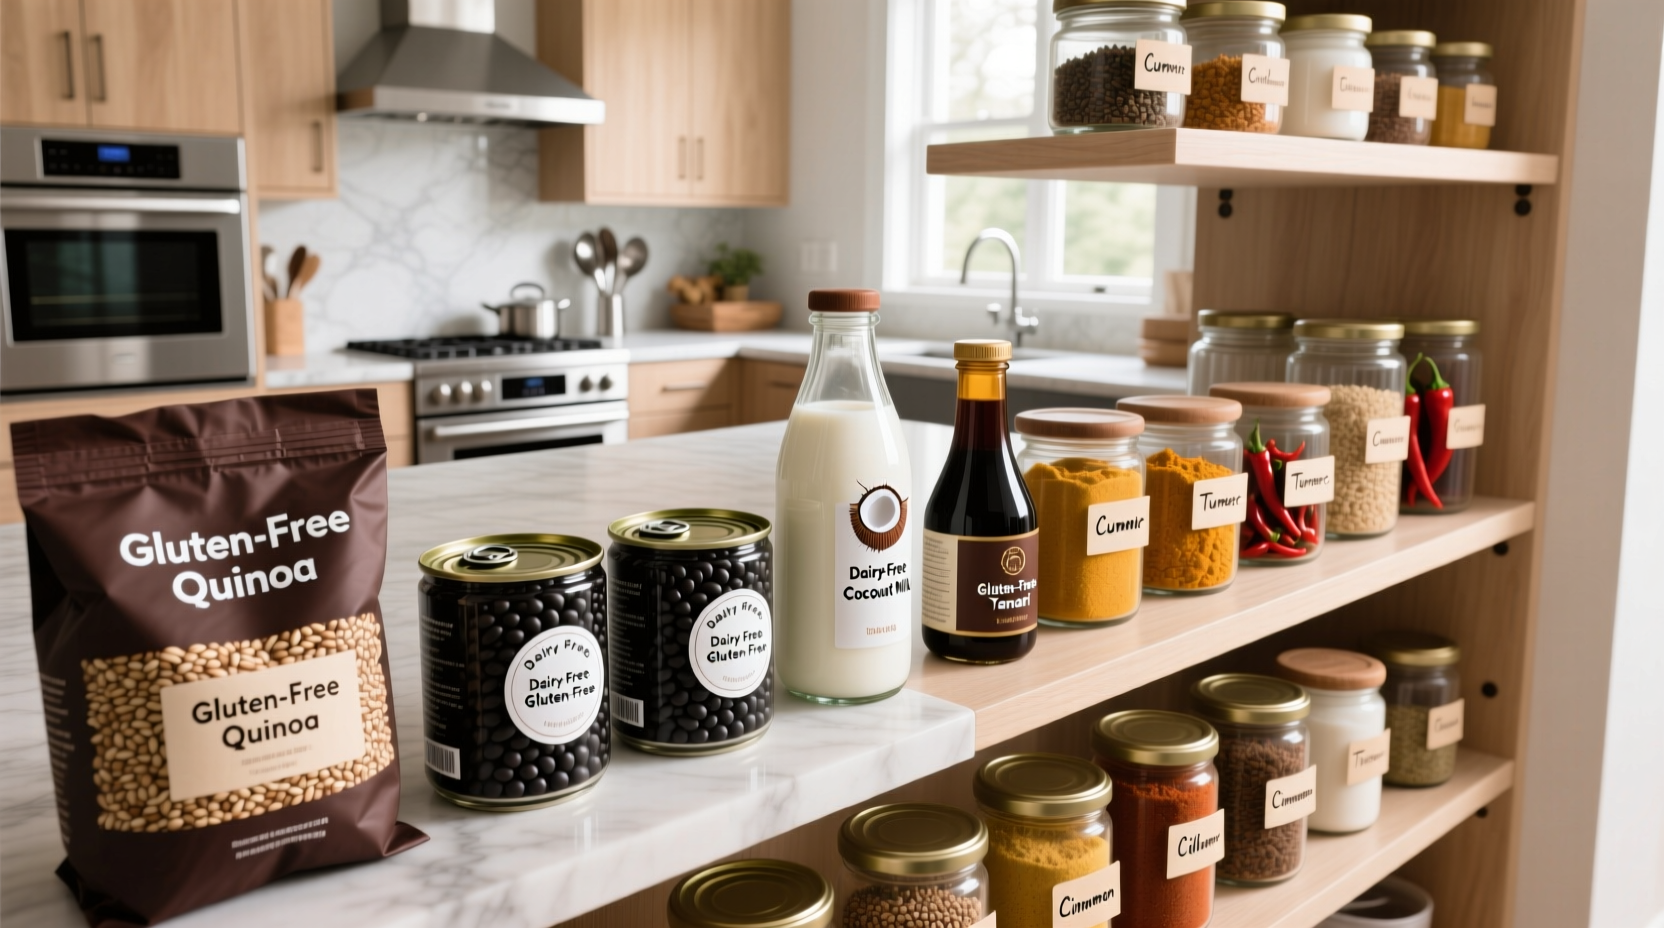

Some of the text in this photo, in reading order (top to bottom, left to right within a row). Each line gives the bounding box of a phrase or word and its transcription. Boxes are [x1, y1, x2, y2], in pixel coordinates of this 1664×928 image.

[119, 510, 350, 567] Gluten-Free
[172, 557, 318, 609] Quinoa
[710, 633, 741, 647] Dairy
[524, 692, 569, 708] Gluten
[529, 674, 563, 691] Dairy
[191, 680, 340, 724] Gluten-Free
[222, 714, 320, 750] Quinoa
